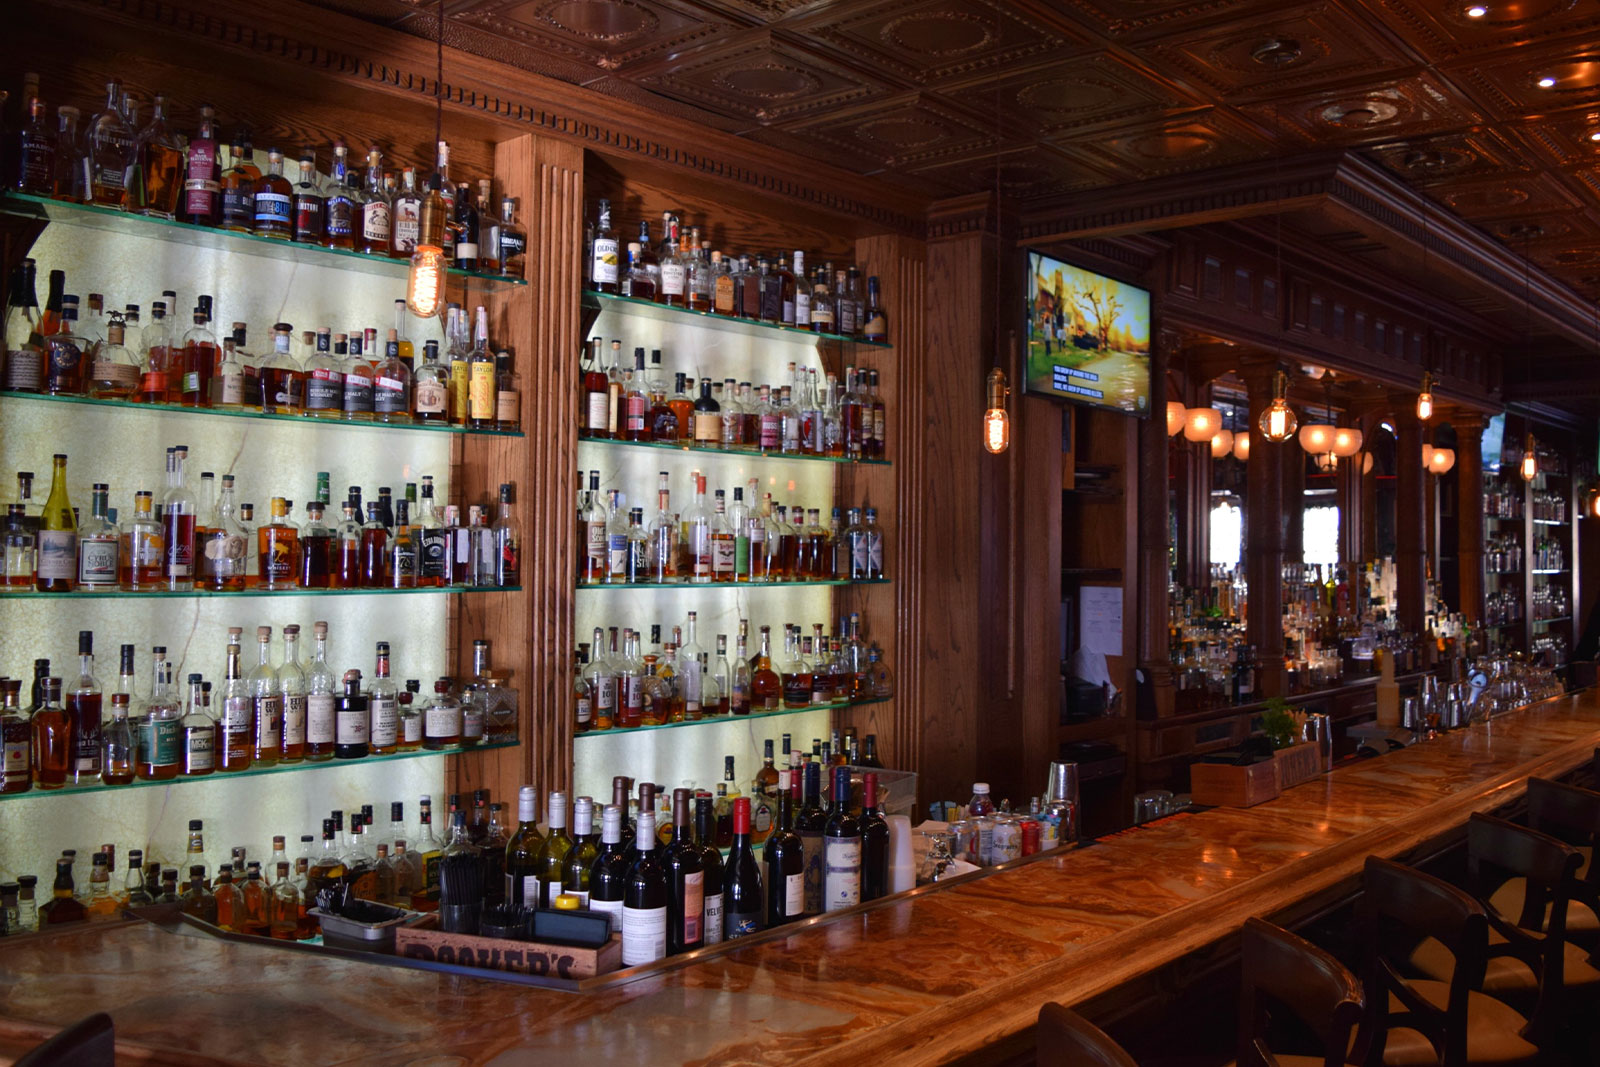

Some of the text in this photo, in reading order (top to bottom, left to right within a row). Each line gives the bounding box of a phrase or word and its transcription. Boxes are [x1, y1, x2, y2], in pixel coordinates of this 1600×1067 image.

[597, 244, 610, 253] OLD
[88, 554, 114, 562] CYRUS
[602, 690, 610, 698] 10
